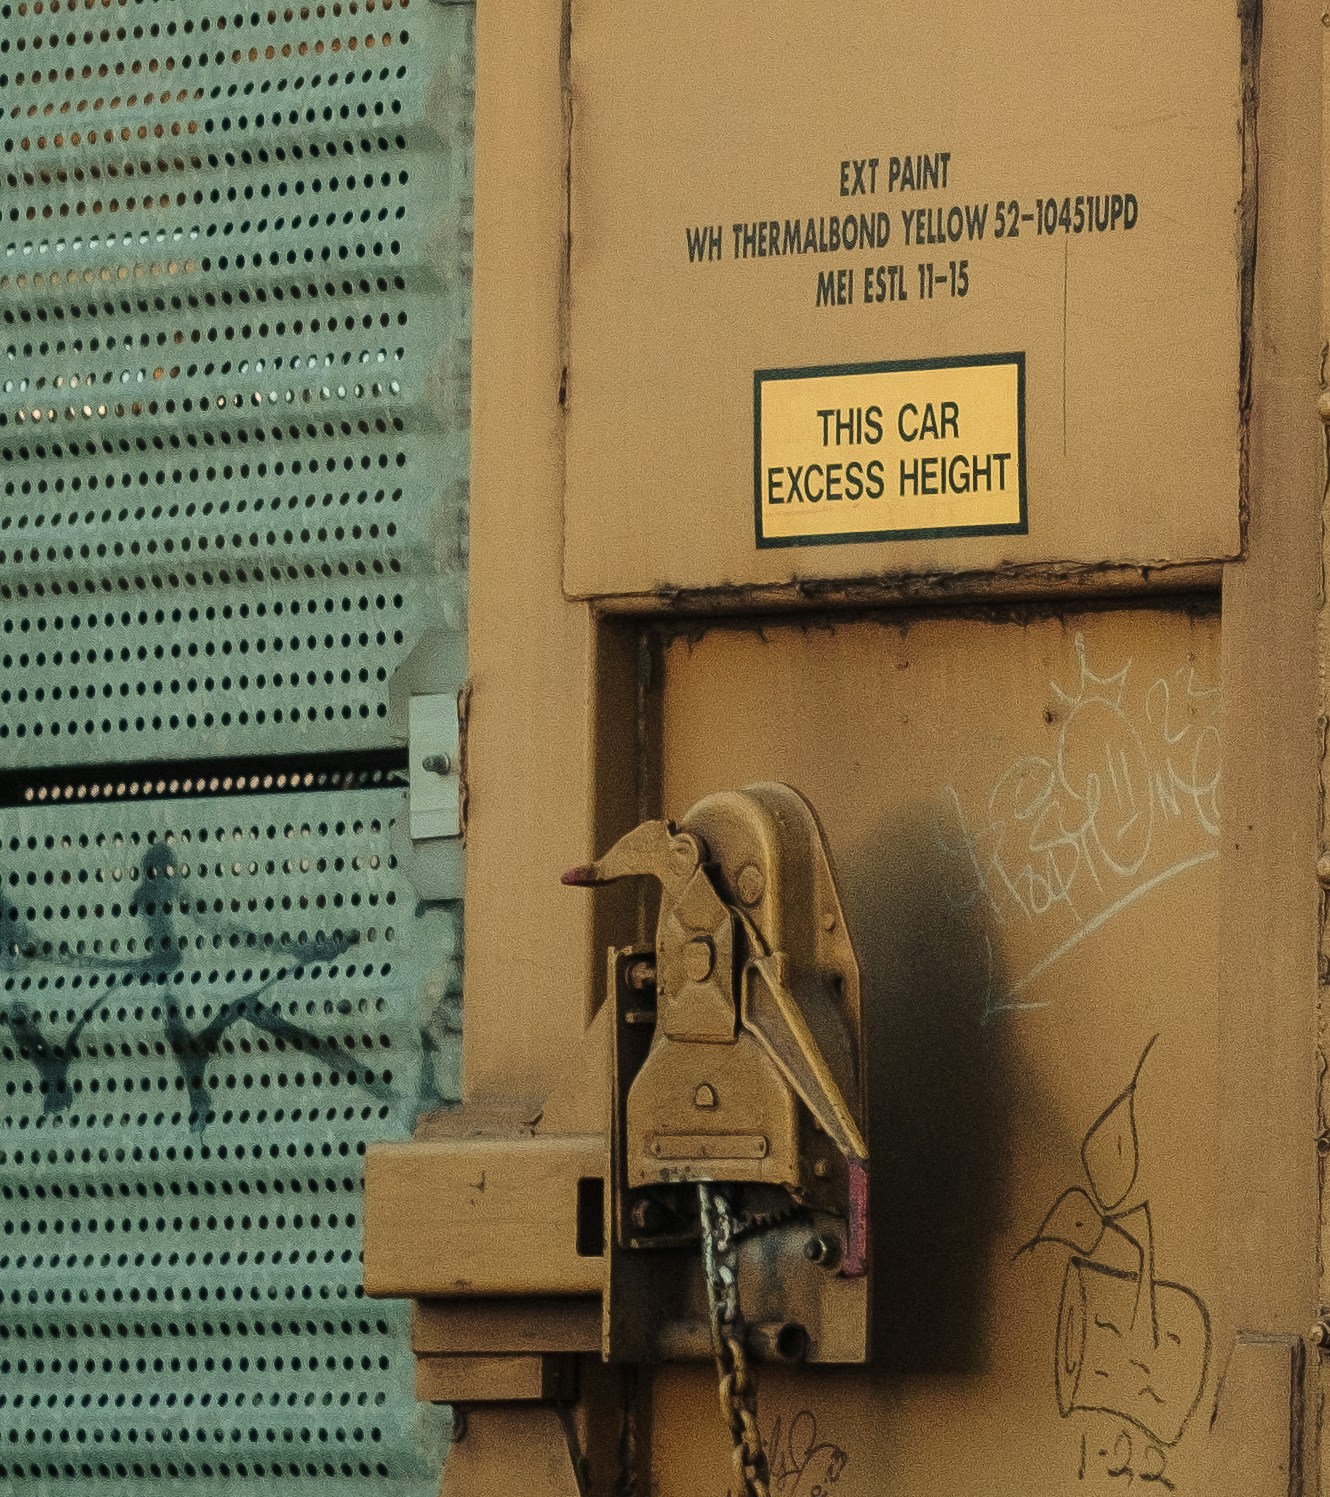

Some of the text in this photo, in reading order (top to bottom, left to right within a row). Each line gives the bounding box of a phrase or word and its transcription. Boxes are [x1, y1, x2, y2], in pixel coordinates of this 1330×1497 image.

[840, 153, 950, 196] EXT PAINT
[687, 224, 722, 262] WH
[733, 210, 890, 258] THERMALBOND
[902, 203, 988, 246] YELLOW
[816, 260, 969, 307] MEI ESTL 11-15
[817, 402, 959, 446] THIS CAR
[768, 453, 1011, 505] EXCESS HEIGHT
